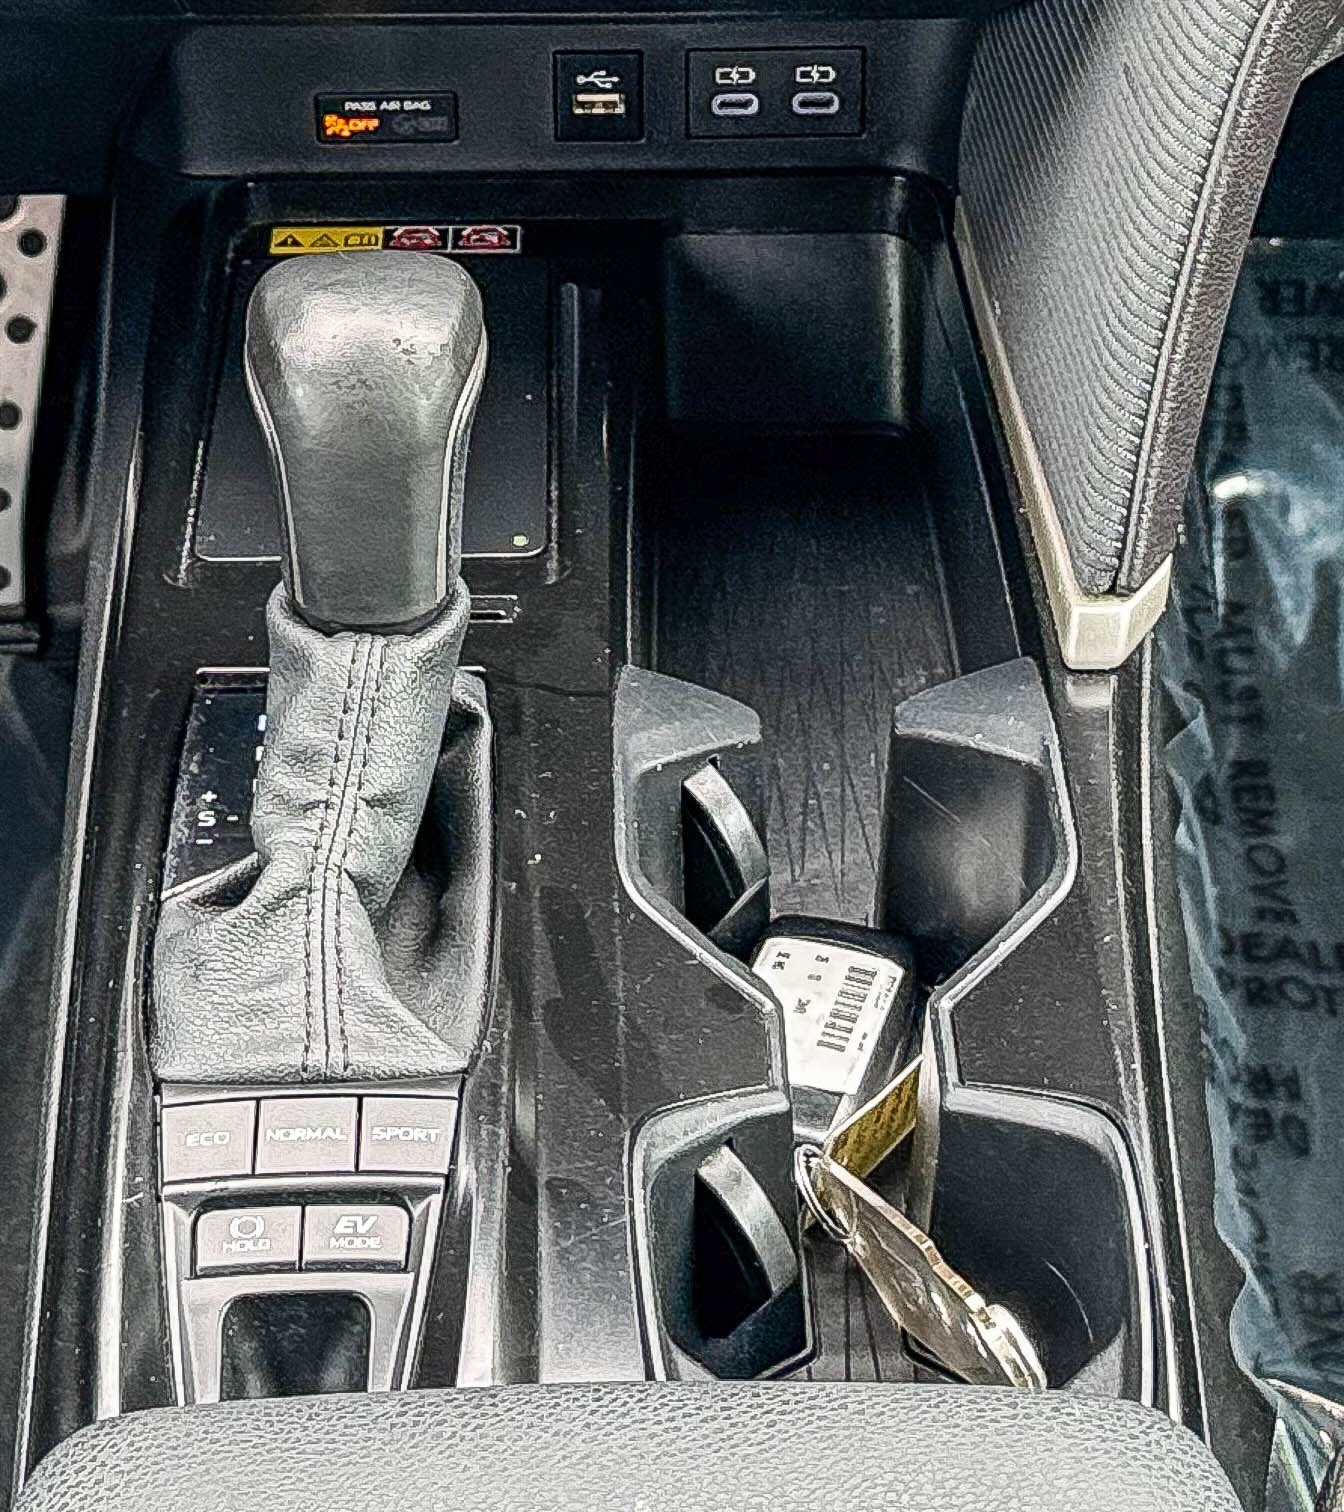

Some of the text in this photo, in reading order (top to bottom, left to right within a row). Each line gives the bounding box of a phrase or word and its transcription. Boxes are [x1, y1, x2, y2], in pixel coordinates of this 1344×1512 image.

[197, 810, 217, 827] S
[186, 1130, 231, 1146] ECO
[265, 1127, 347, 1142] NORMAL
[371, 1126, 440, 1142] SPORT
[333, 1215, 378, 1234] EV
[222, 1238, 272, 1254] HOLD
[329, 1236, 382, 1249] MODE
